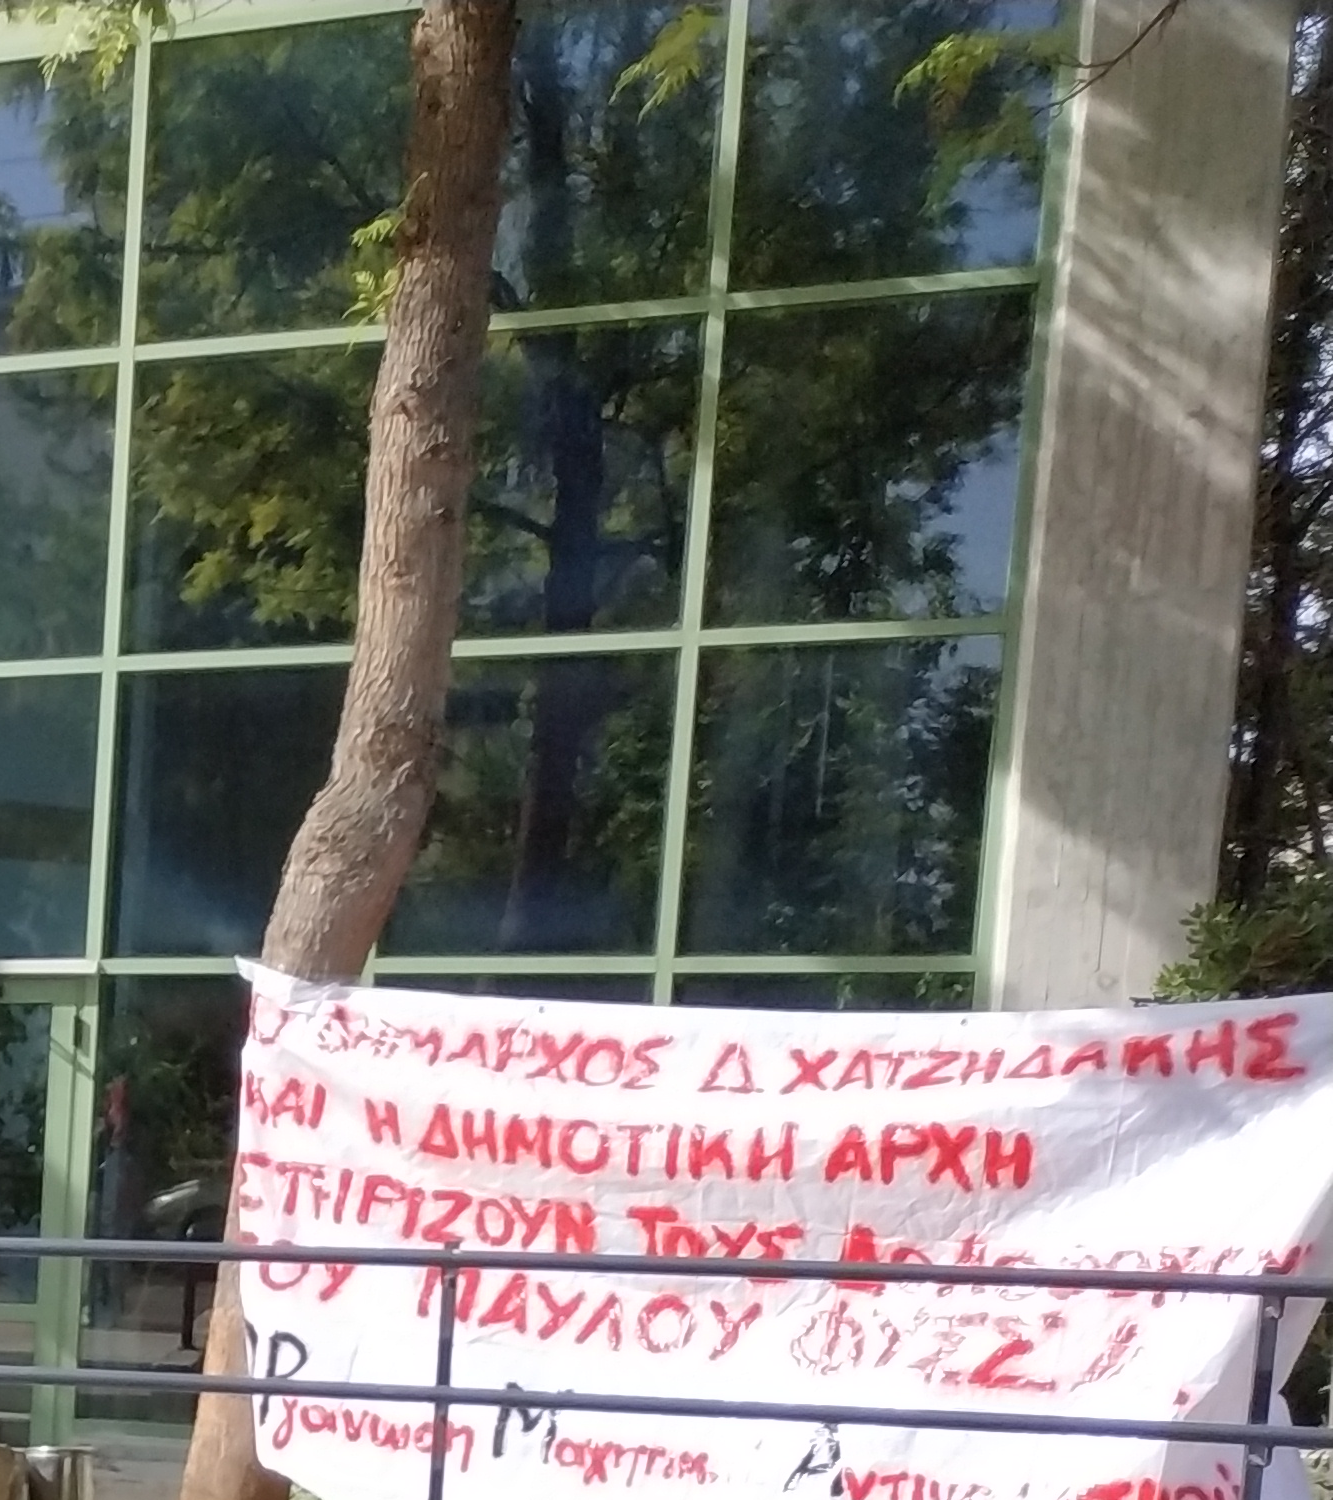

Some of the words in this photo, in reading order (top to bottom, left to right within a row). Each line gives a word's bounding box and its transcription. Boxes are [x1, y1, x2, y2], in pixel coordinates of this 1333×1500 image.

[697, 1042, 765, 1094] Δ
[779, 1012, 1308, 1096] ΧΑΤΖΗΔΑΚΗΣ
[364, 1097, 402, 1146] Η
[416, 1103, 799, 1183] ΔΗΜΟΤΙΚΗ
[824, 1124, 1033, 1192] ΑΡΧΗ
